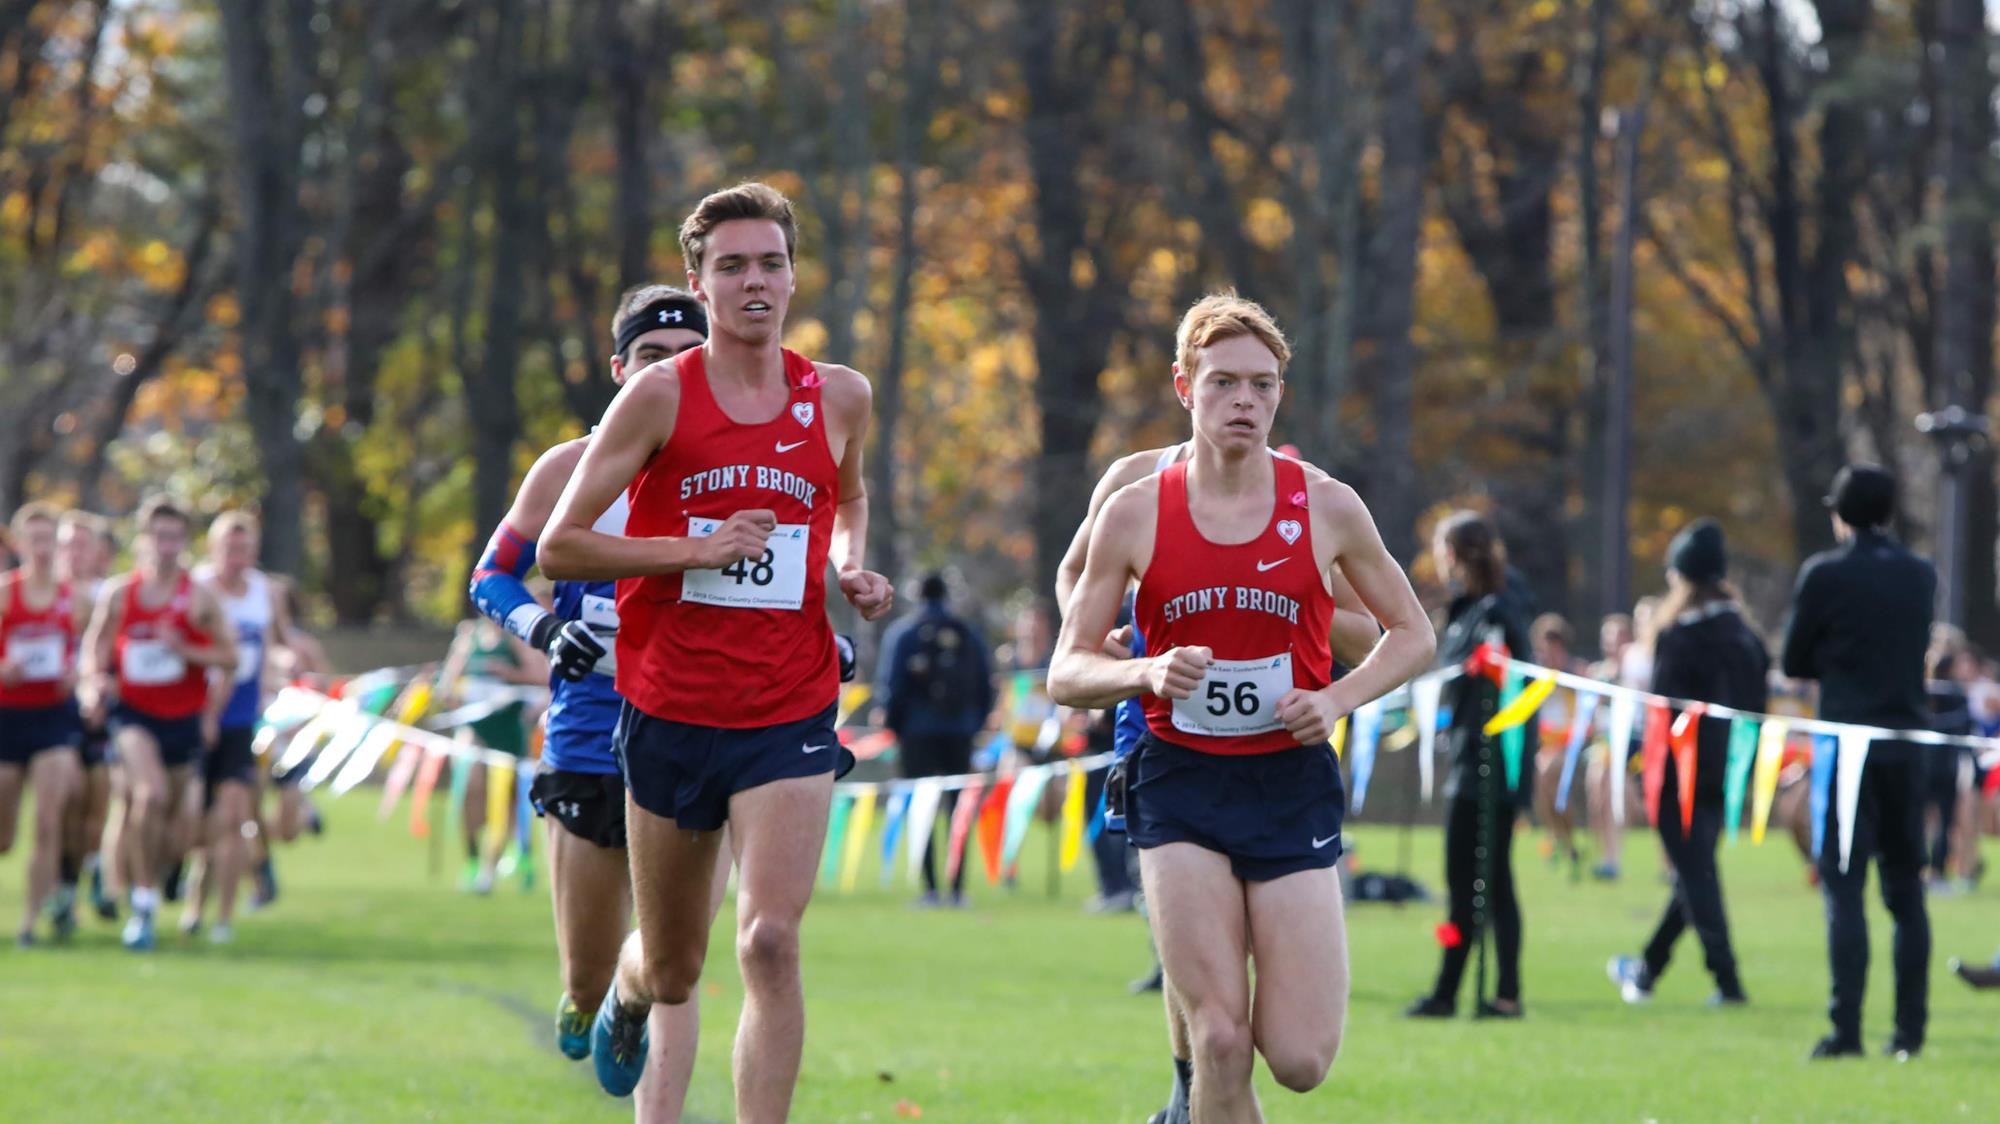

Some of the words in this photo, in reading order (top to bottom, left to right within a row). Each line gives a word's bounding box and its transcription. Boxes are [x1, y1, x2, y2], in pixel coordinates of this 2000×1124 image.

[679, 464, 750, 501] STONY
[755, 465, 817, 510] BROOK
[721, 547, 774, 586] 48
[1163, 586, 1228, 623] STONY
[1235, 586, 1300, 625] BROOK
[1206, 680, 1260, 717] 56
